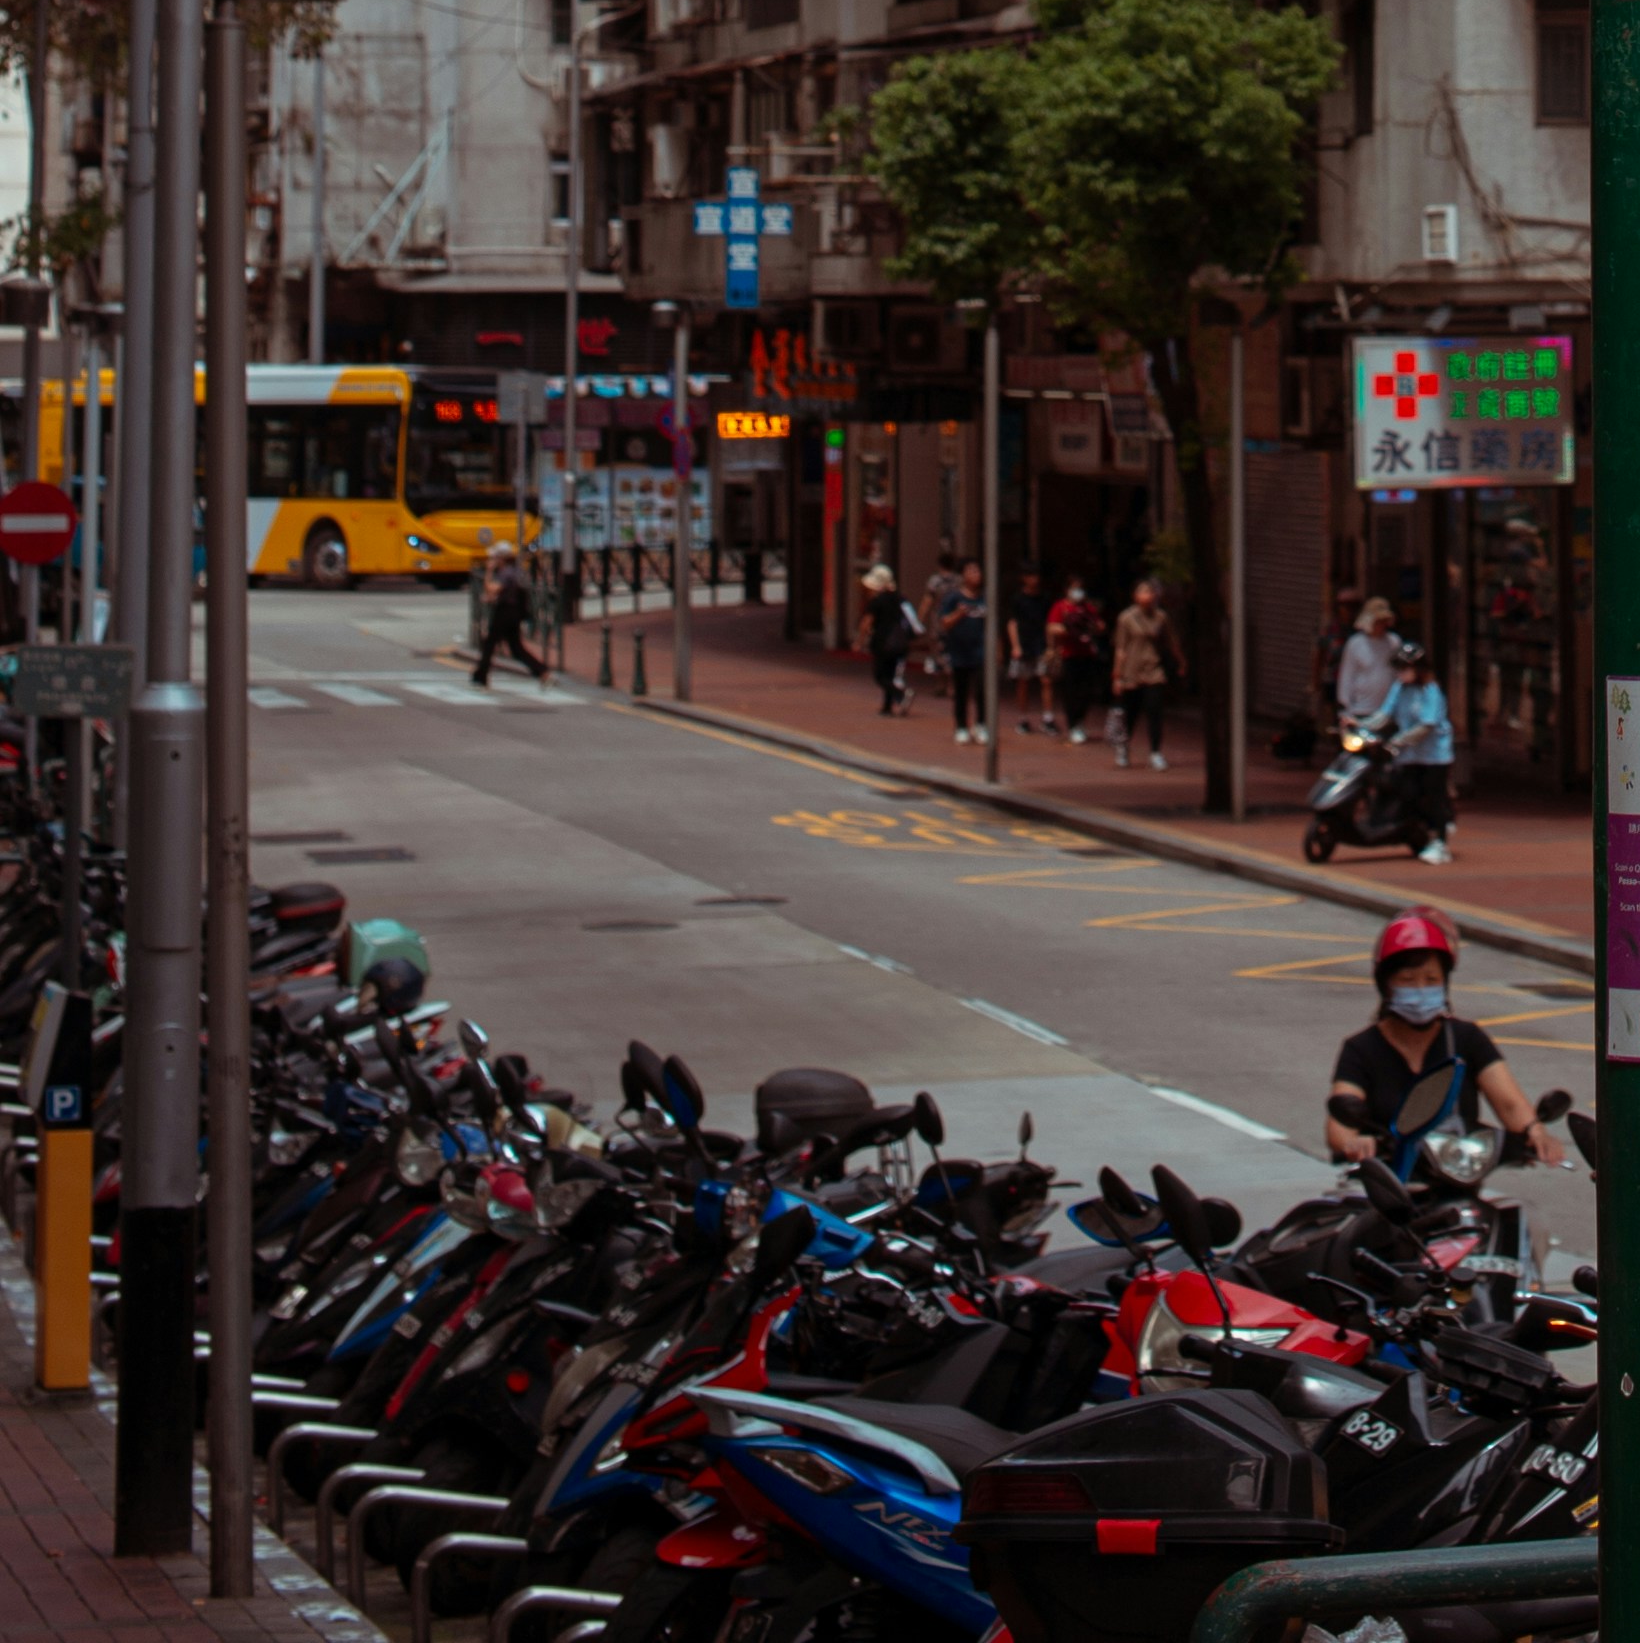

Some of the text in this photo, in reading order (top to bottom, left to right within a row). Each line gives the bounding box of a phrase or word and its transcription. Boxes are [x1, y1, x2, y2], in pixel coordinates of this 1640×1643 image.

[1371, 429, 1558, 474] 永信藥房
[1620, 902, 1636, 911] Scan
